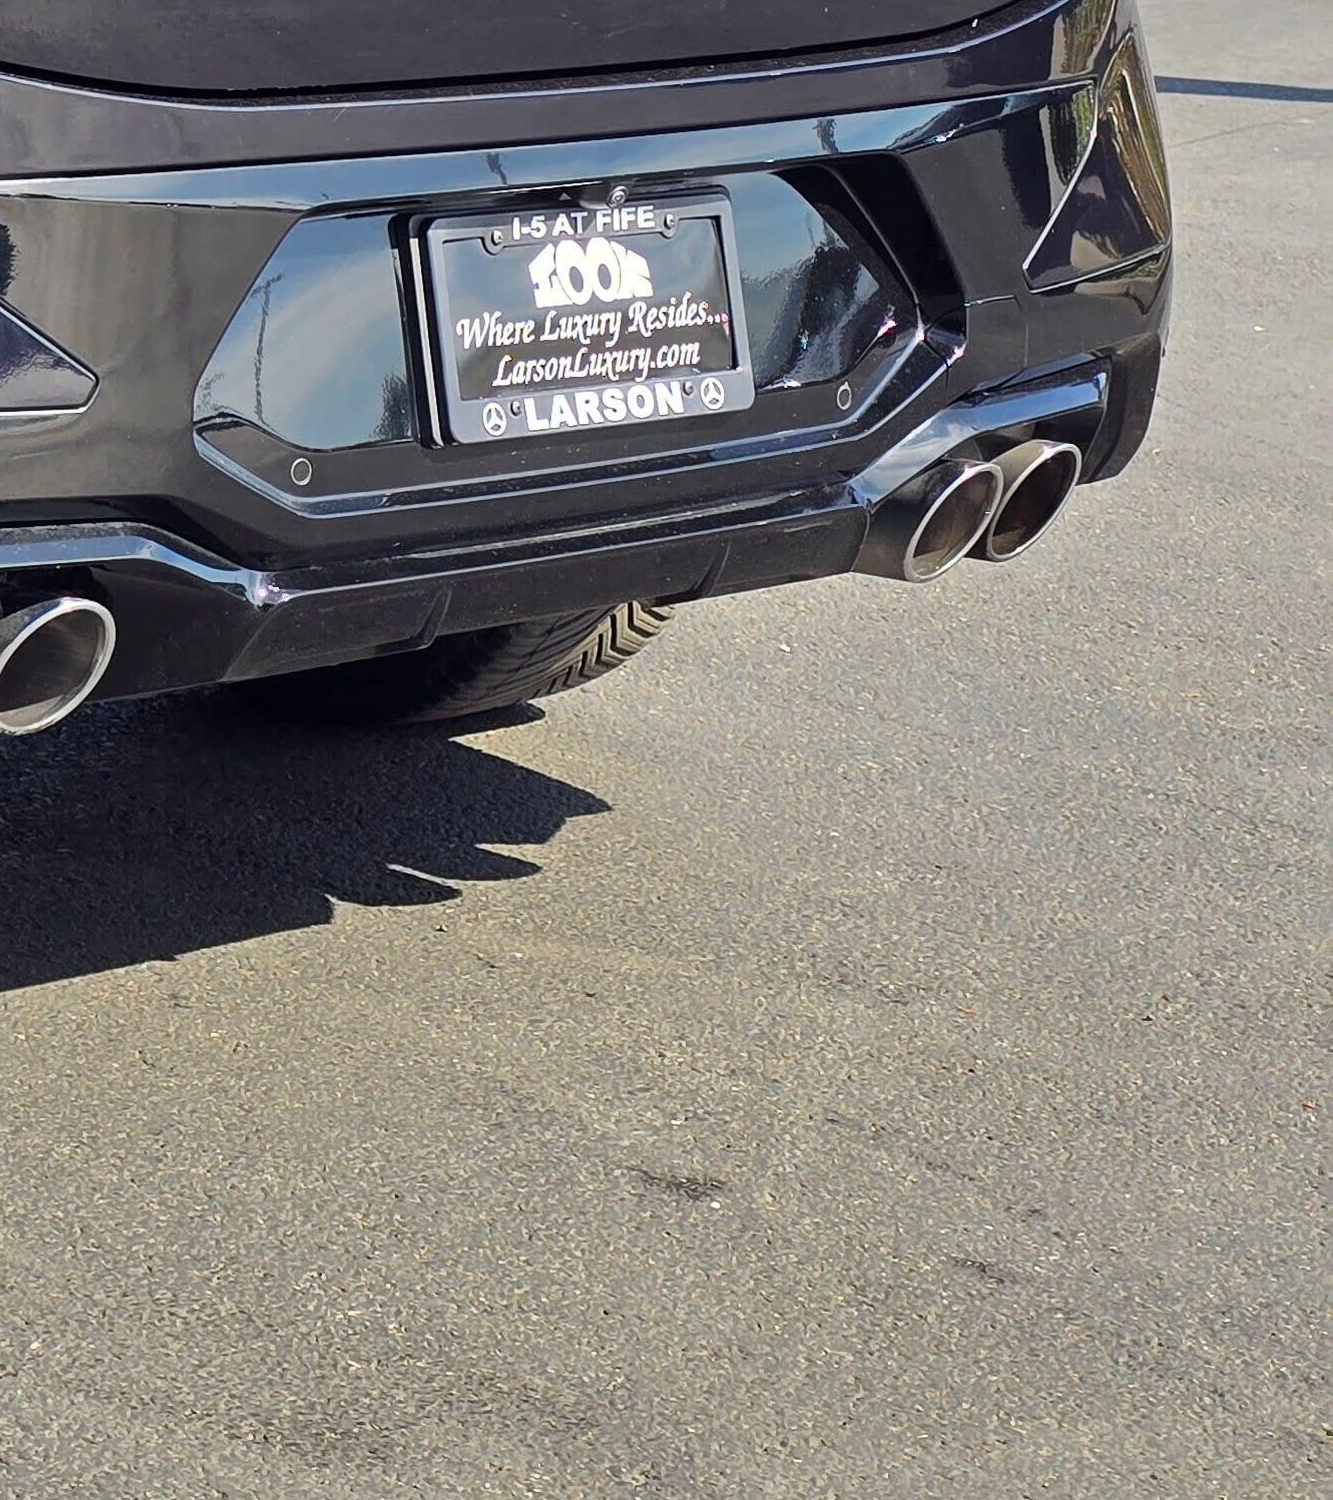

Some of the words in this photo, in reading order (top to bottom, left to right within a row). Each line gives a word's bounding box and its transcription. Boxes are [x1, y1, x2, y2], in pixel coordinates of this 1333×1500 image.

[512, 215, 548, 241] I-5
[552, 211, 588, 236] AT
[595, 205, 656, 233] FIFE
[455, 310, 535, 350] Where
[539, 309, 622, 348] Luxury
[491, 341, 701, 388] LarsonLuxury.com
[523, 380, 684, 432] LARSON
